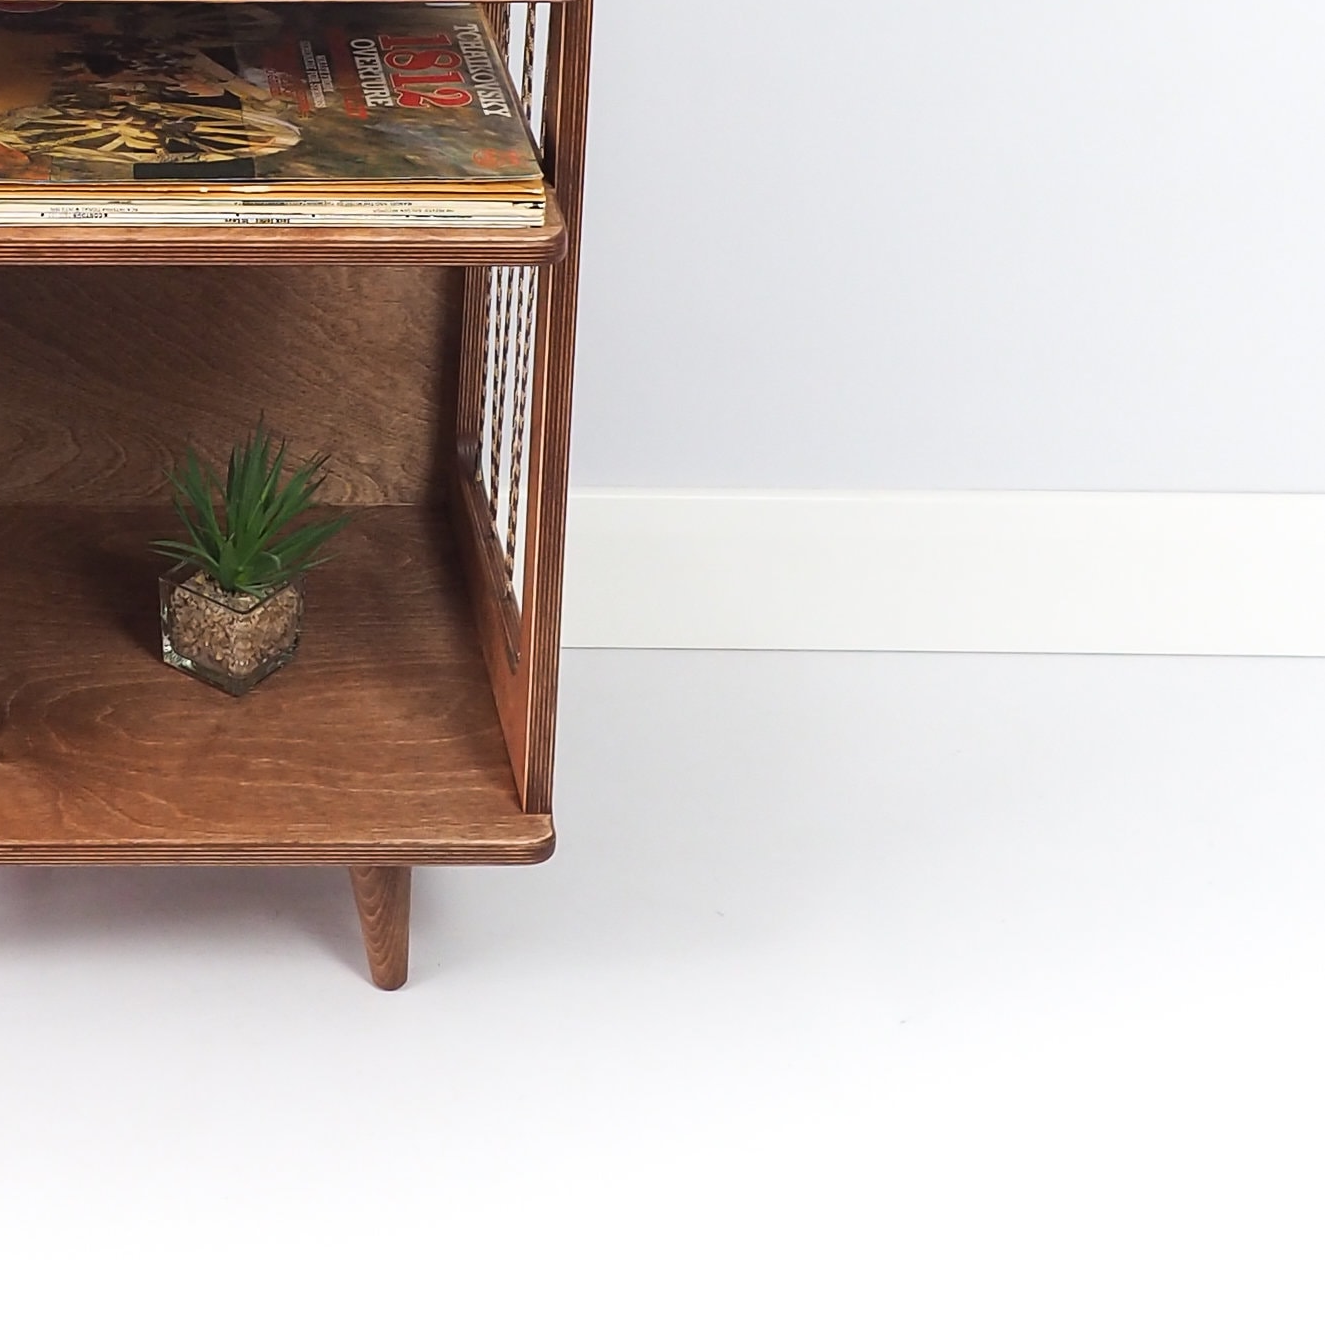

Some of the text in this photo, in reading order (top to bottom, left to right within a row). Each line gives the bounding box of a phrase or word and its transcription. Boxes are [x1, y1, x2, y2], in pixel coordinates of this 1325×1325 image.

[350, 38, 394, 108] OVERTURE
[378, 34, 473, 109] 1812
[453, 23, 512, 118] TCHAIKOVSKY
